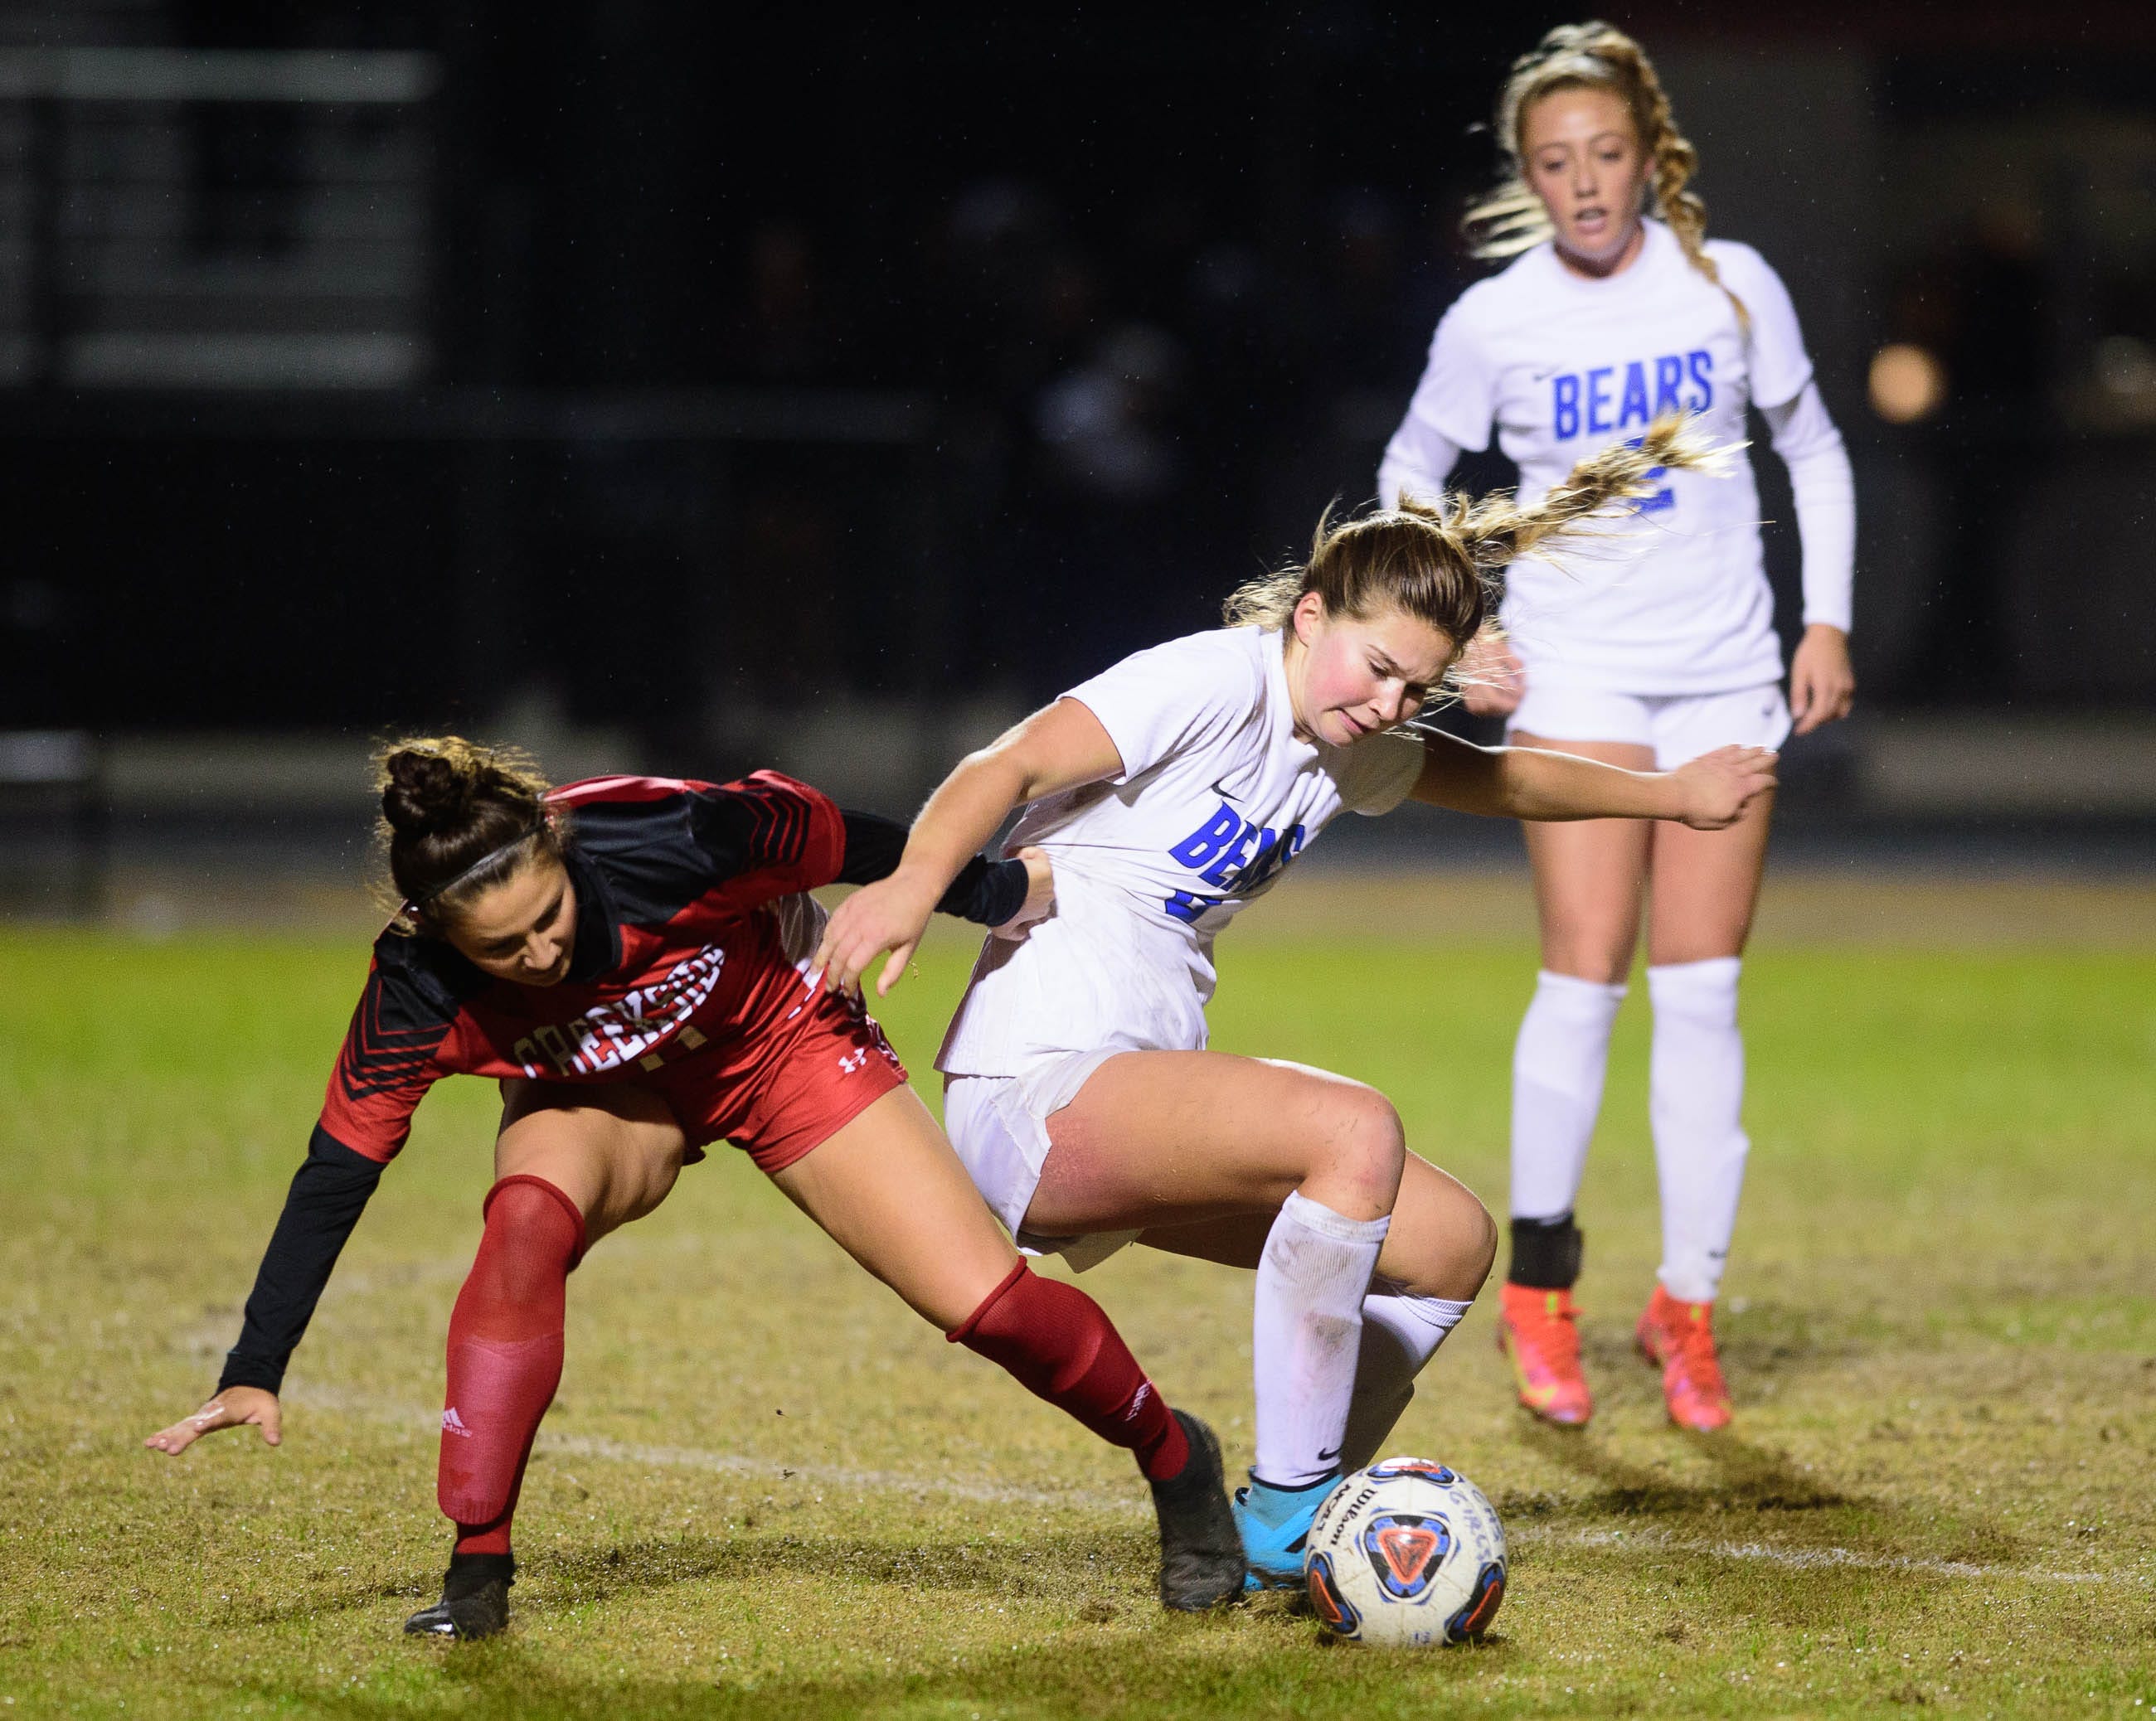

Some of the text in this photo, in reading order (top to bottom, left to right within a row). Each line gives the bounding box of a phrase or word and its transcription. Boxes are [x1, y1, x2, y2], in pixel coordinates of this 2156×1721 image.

[1551, 349, 1713, 442] BEARS
[1330, 1487, 1378, 1546] Wilson
[1449, 1491, 1492, 1562] GIRLS
